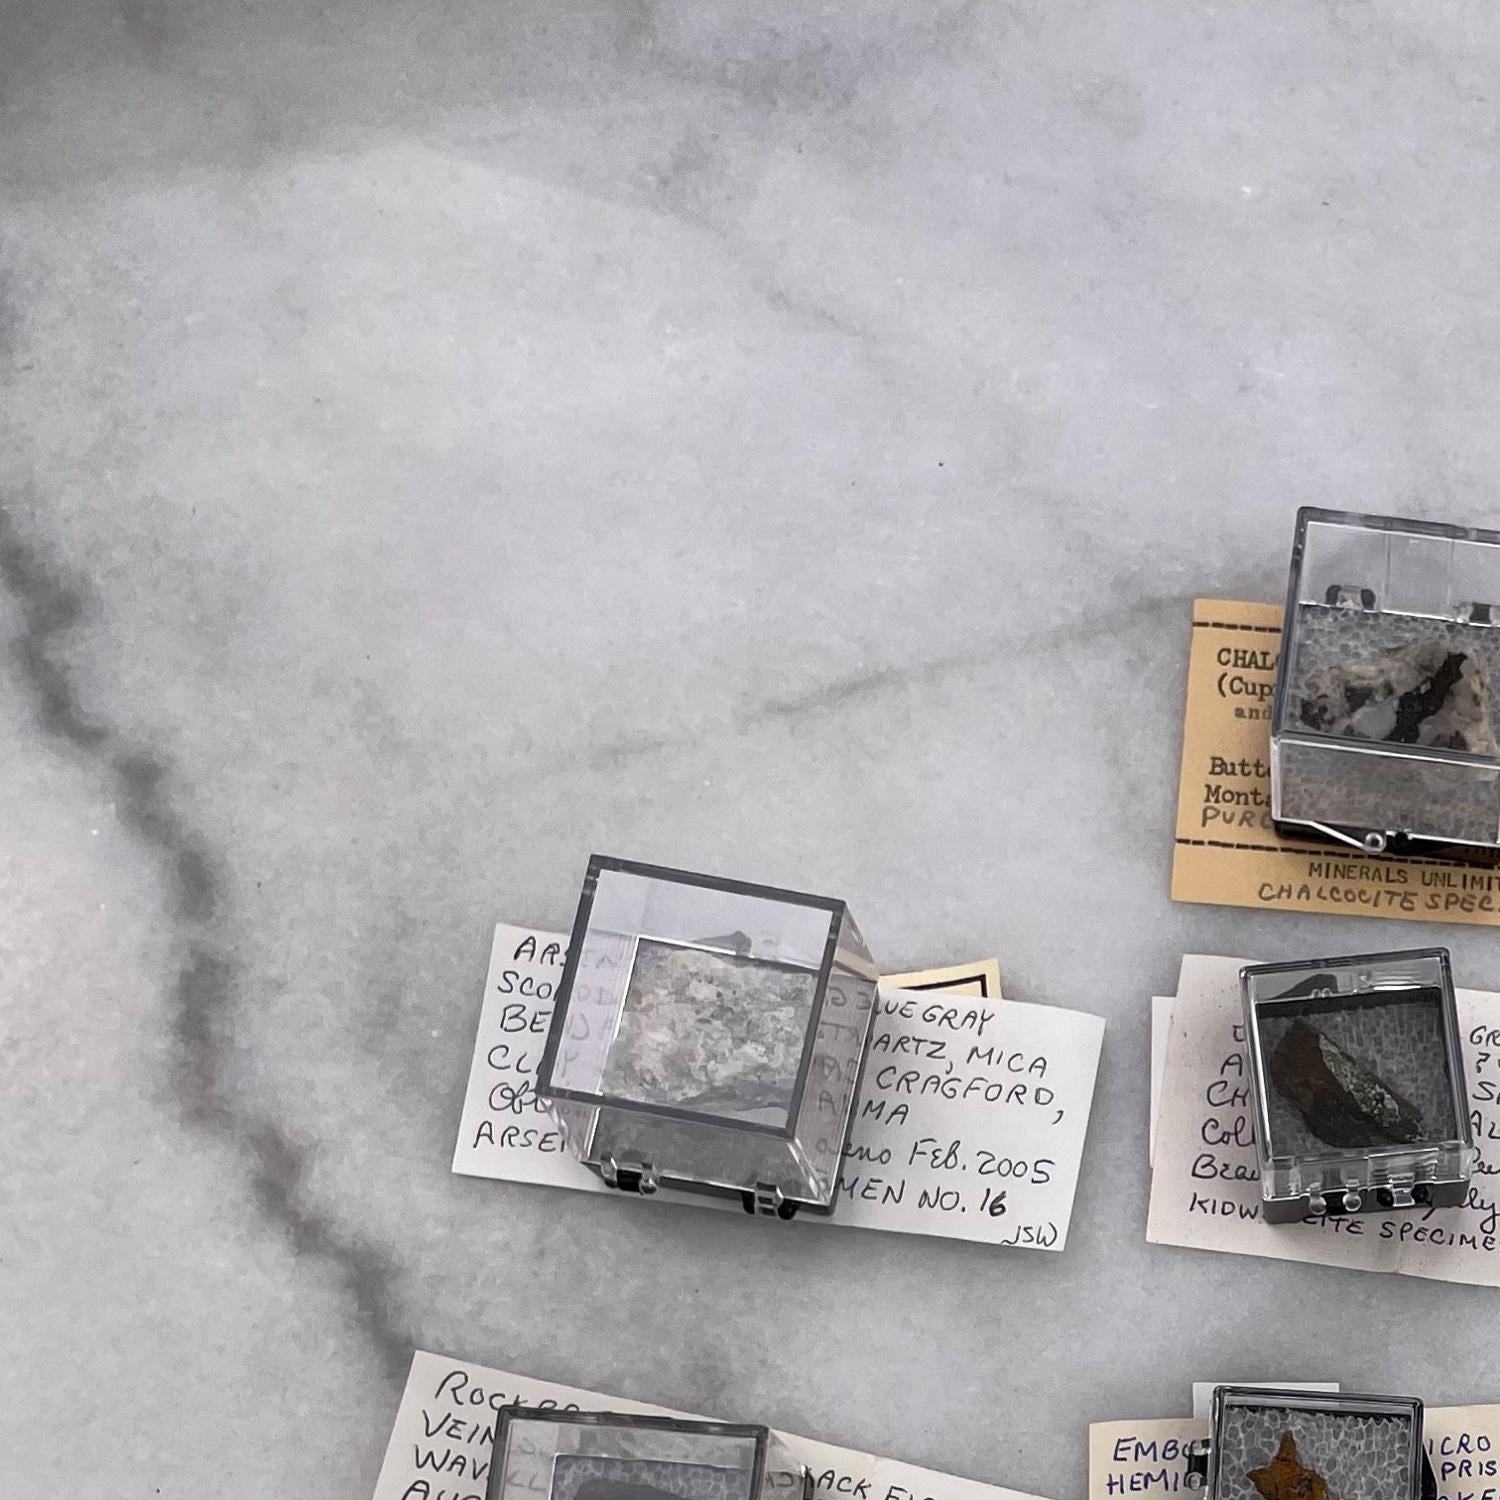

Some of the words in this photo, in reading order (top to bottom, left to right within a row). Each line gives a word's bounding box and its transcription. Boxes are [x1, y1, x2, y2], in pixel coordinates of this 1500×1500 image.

[1217, 672, 1276, 702] (Cup
[1308, 861, 1409, 885] MINERALS
[1257, 883, 1416, 911] CHALCOCITE
[500, 1003, 552, 1033] BE
[922, 1004, 995, 1036] GRAY
[873, 1033, 954, 1075] ARTZ,
[966, 1046, 1048, 1079] MICA
[862, 1099, 910, 1126] MA
[976, 1150, 1056, 1185] 2005
[918, 1185, 967, 1213] NO.
[980, 1187, 1008, 1218] 16
[1428, 1433, 1491, 1456] ICRO
[414, 1444, 490, 1481] WAV
[1106, 1468, 1190, 1496] HEMI
